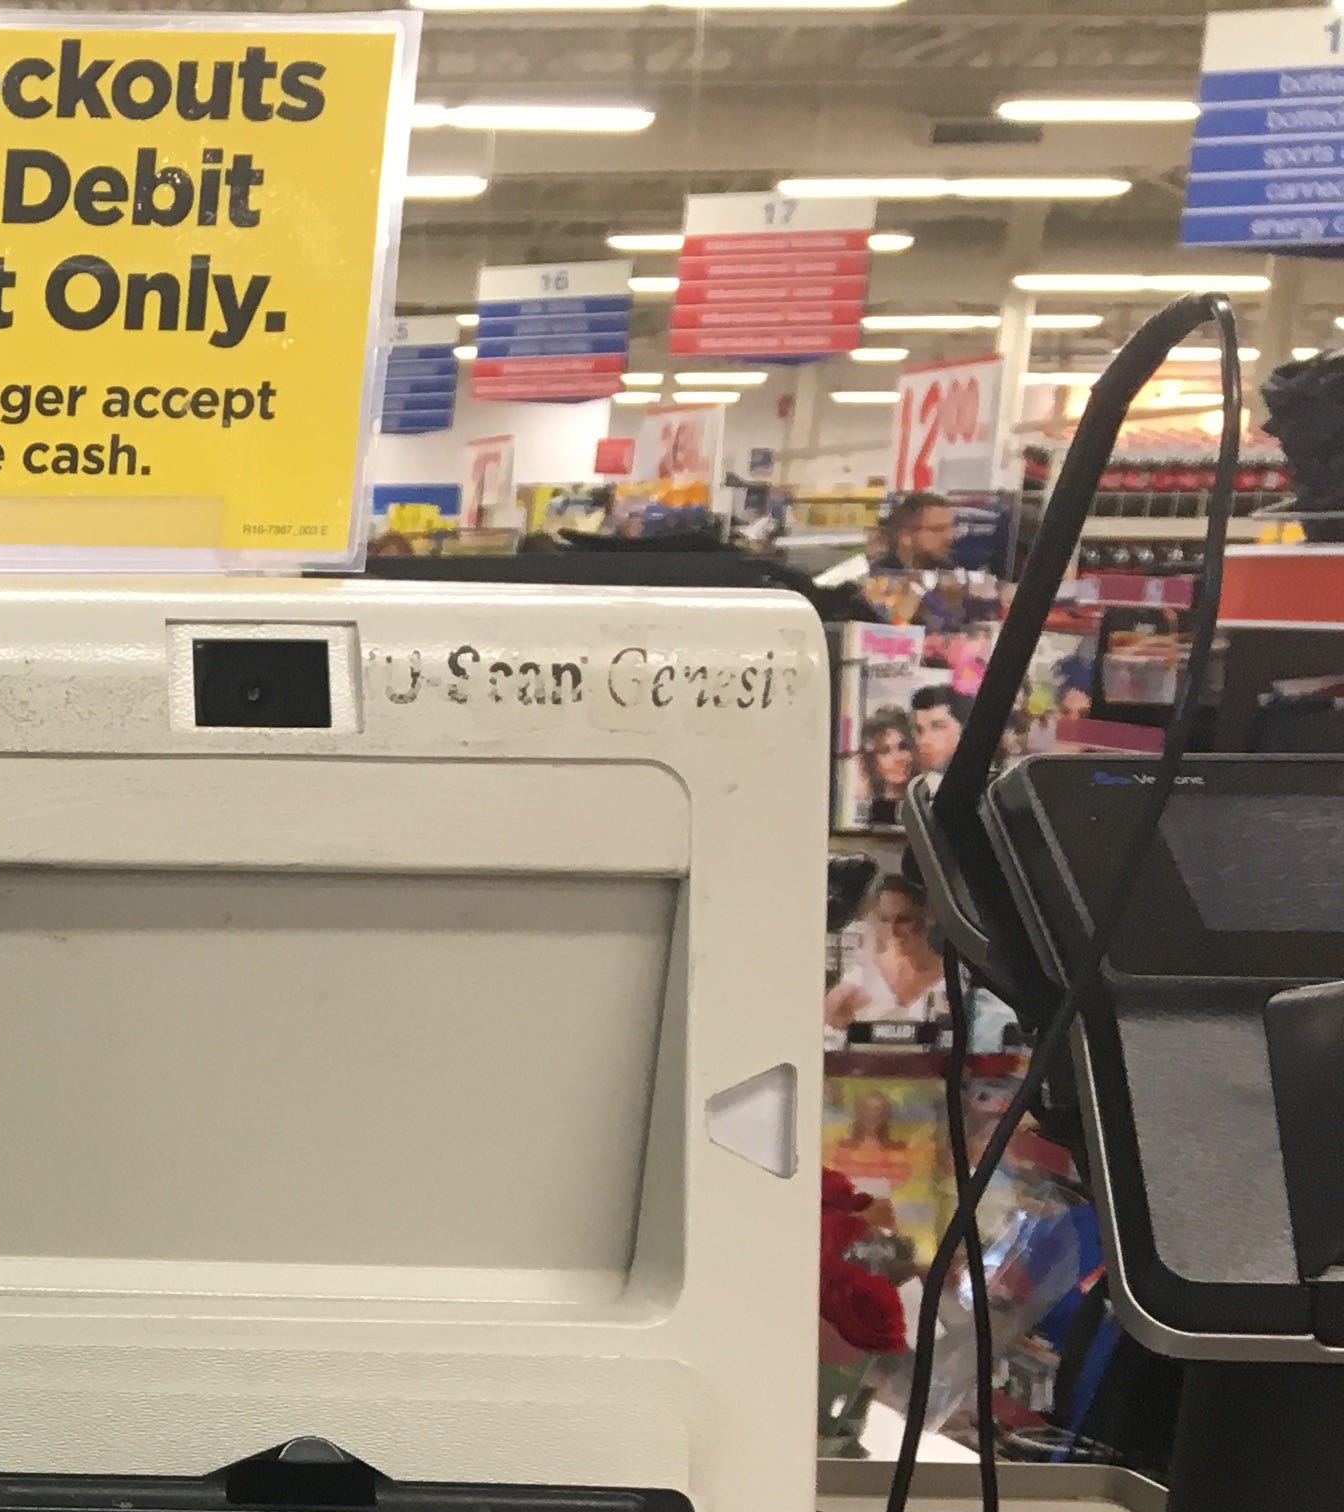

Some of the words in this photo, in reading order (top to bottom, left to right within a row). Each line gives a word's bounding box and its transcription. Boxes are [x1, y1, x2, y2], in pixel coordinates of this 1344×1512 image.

[2, 147, 264, 228] Debit
[763, 200, 797, 225] 17
[45, 254, 286, 349] Only.
[102, 380, 277, 429] accept
[23, 433, 152, 476] cash.
[1132, 773, 1206, 786] Veone
